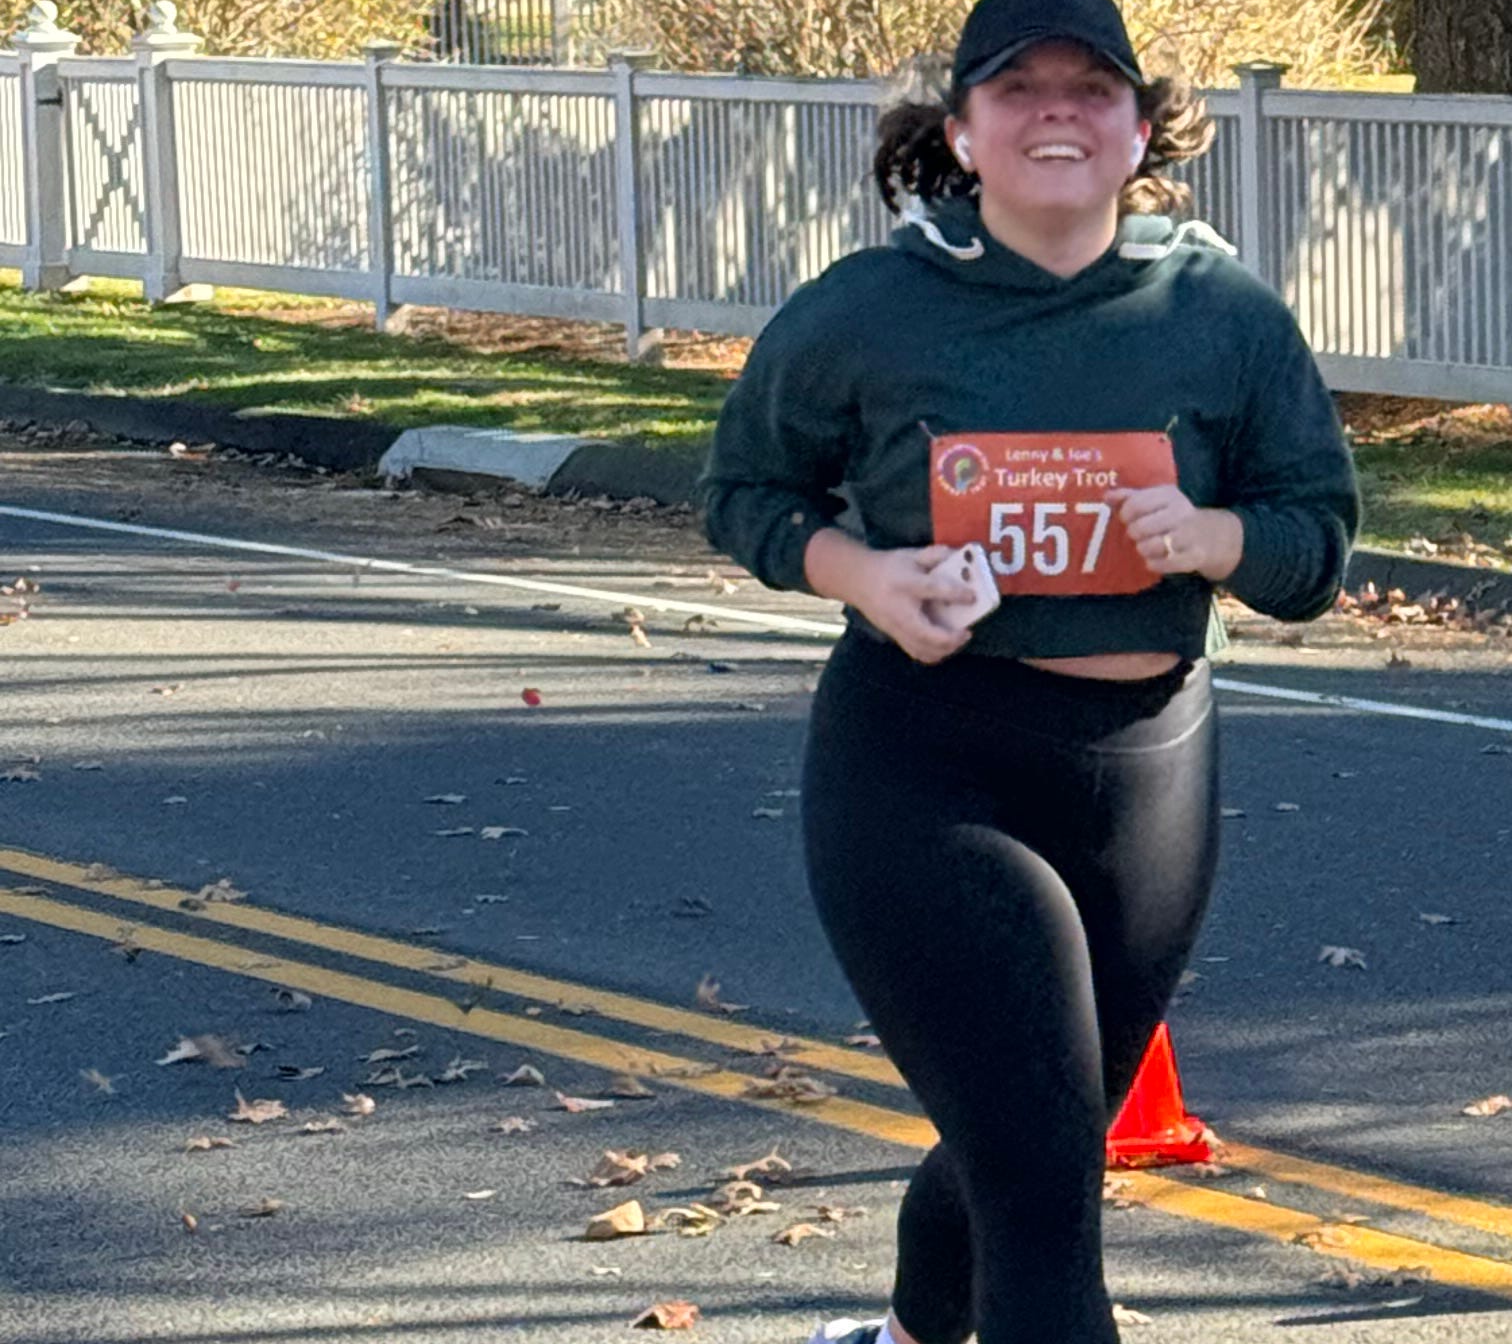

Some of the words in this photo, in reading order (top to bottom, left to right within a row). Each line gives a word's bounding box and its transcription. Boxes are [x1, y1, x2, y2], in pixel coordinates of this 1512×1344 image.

[1052, 447, 1064, 462] &
[994, 467, 1068, 491] Turkey
[1074, 468, 1118, 487] Trot
[990, 502, 1111, 575] 557
